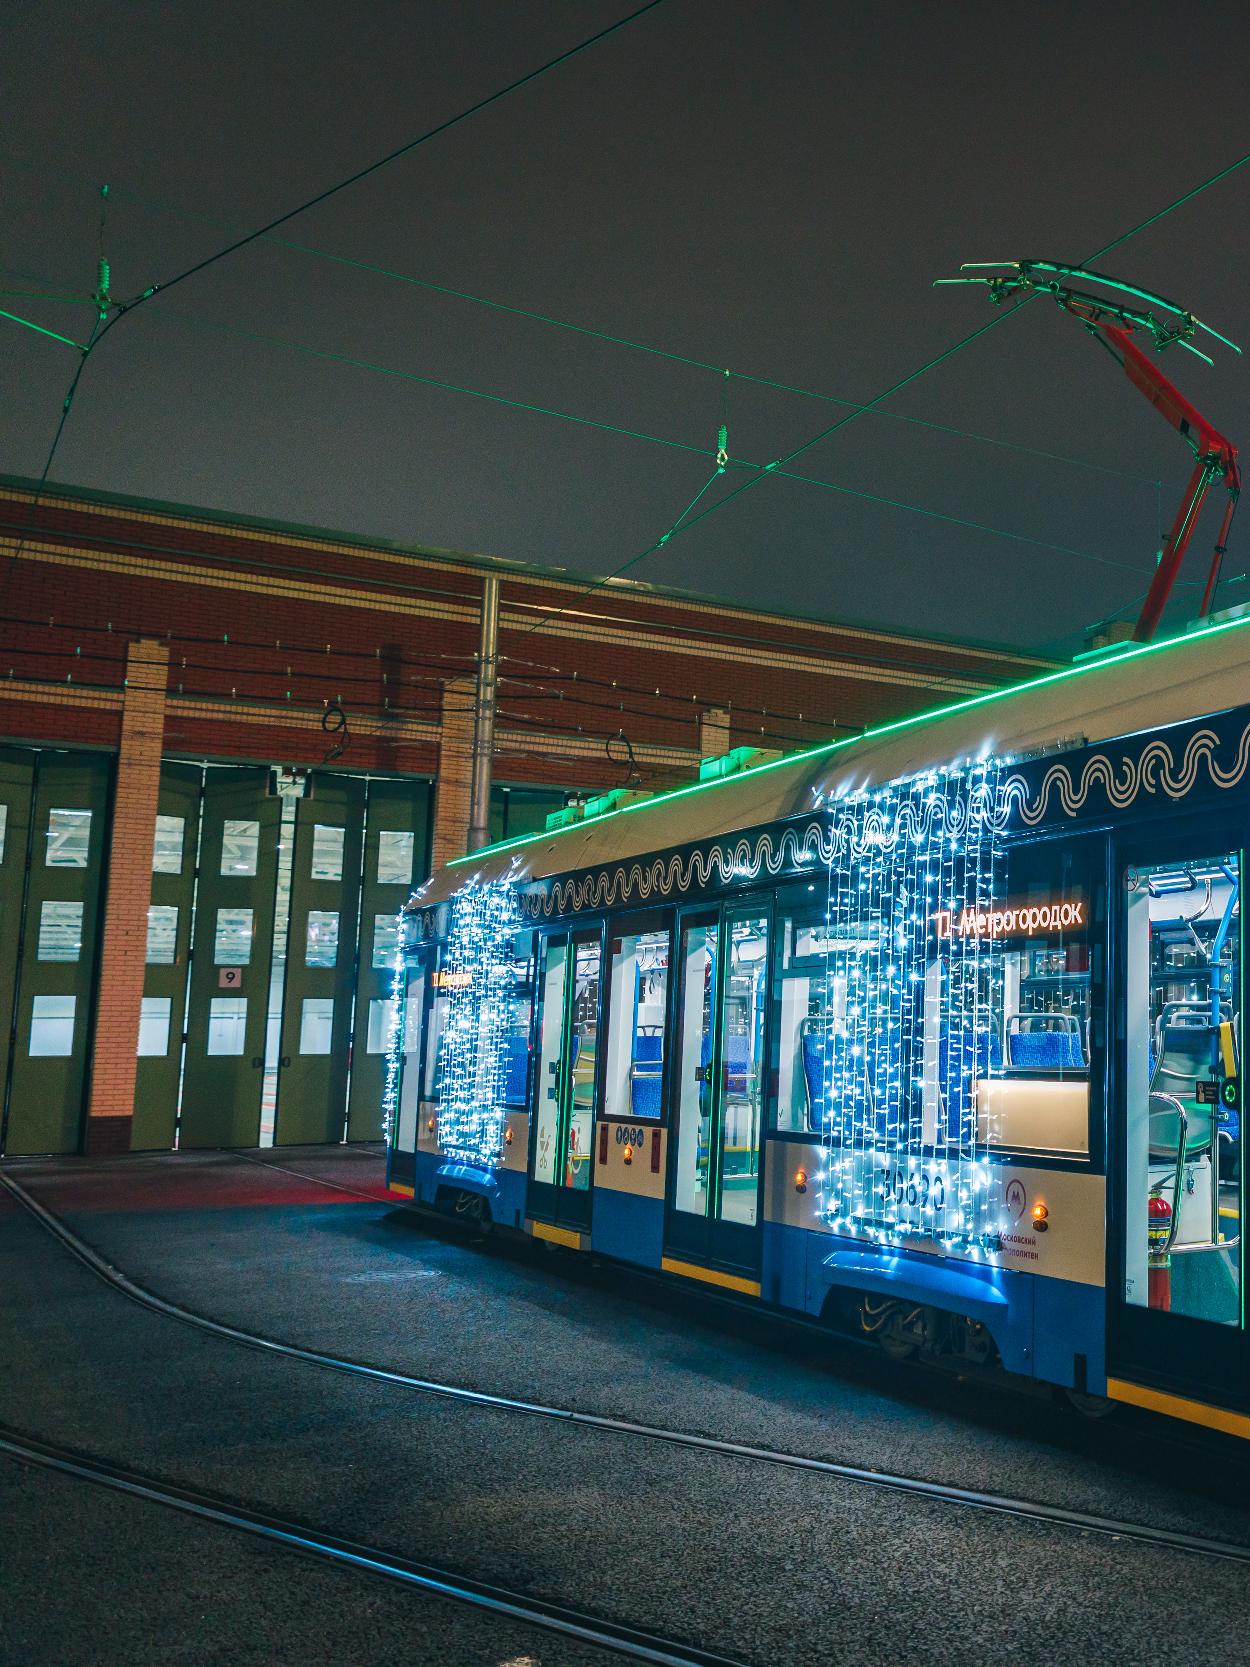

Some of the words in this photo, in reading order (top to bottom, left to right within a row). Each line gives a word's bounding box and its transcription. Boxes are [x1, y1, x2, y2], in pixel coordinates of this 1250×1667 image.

[959, 902, 1083, 939] Метрогородок
[225, 971, 236, 984] 9
[880, 1168, 945, 1212] 30690
